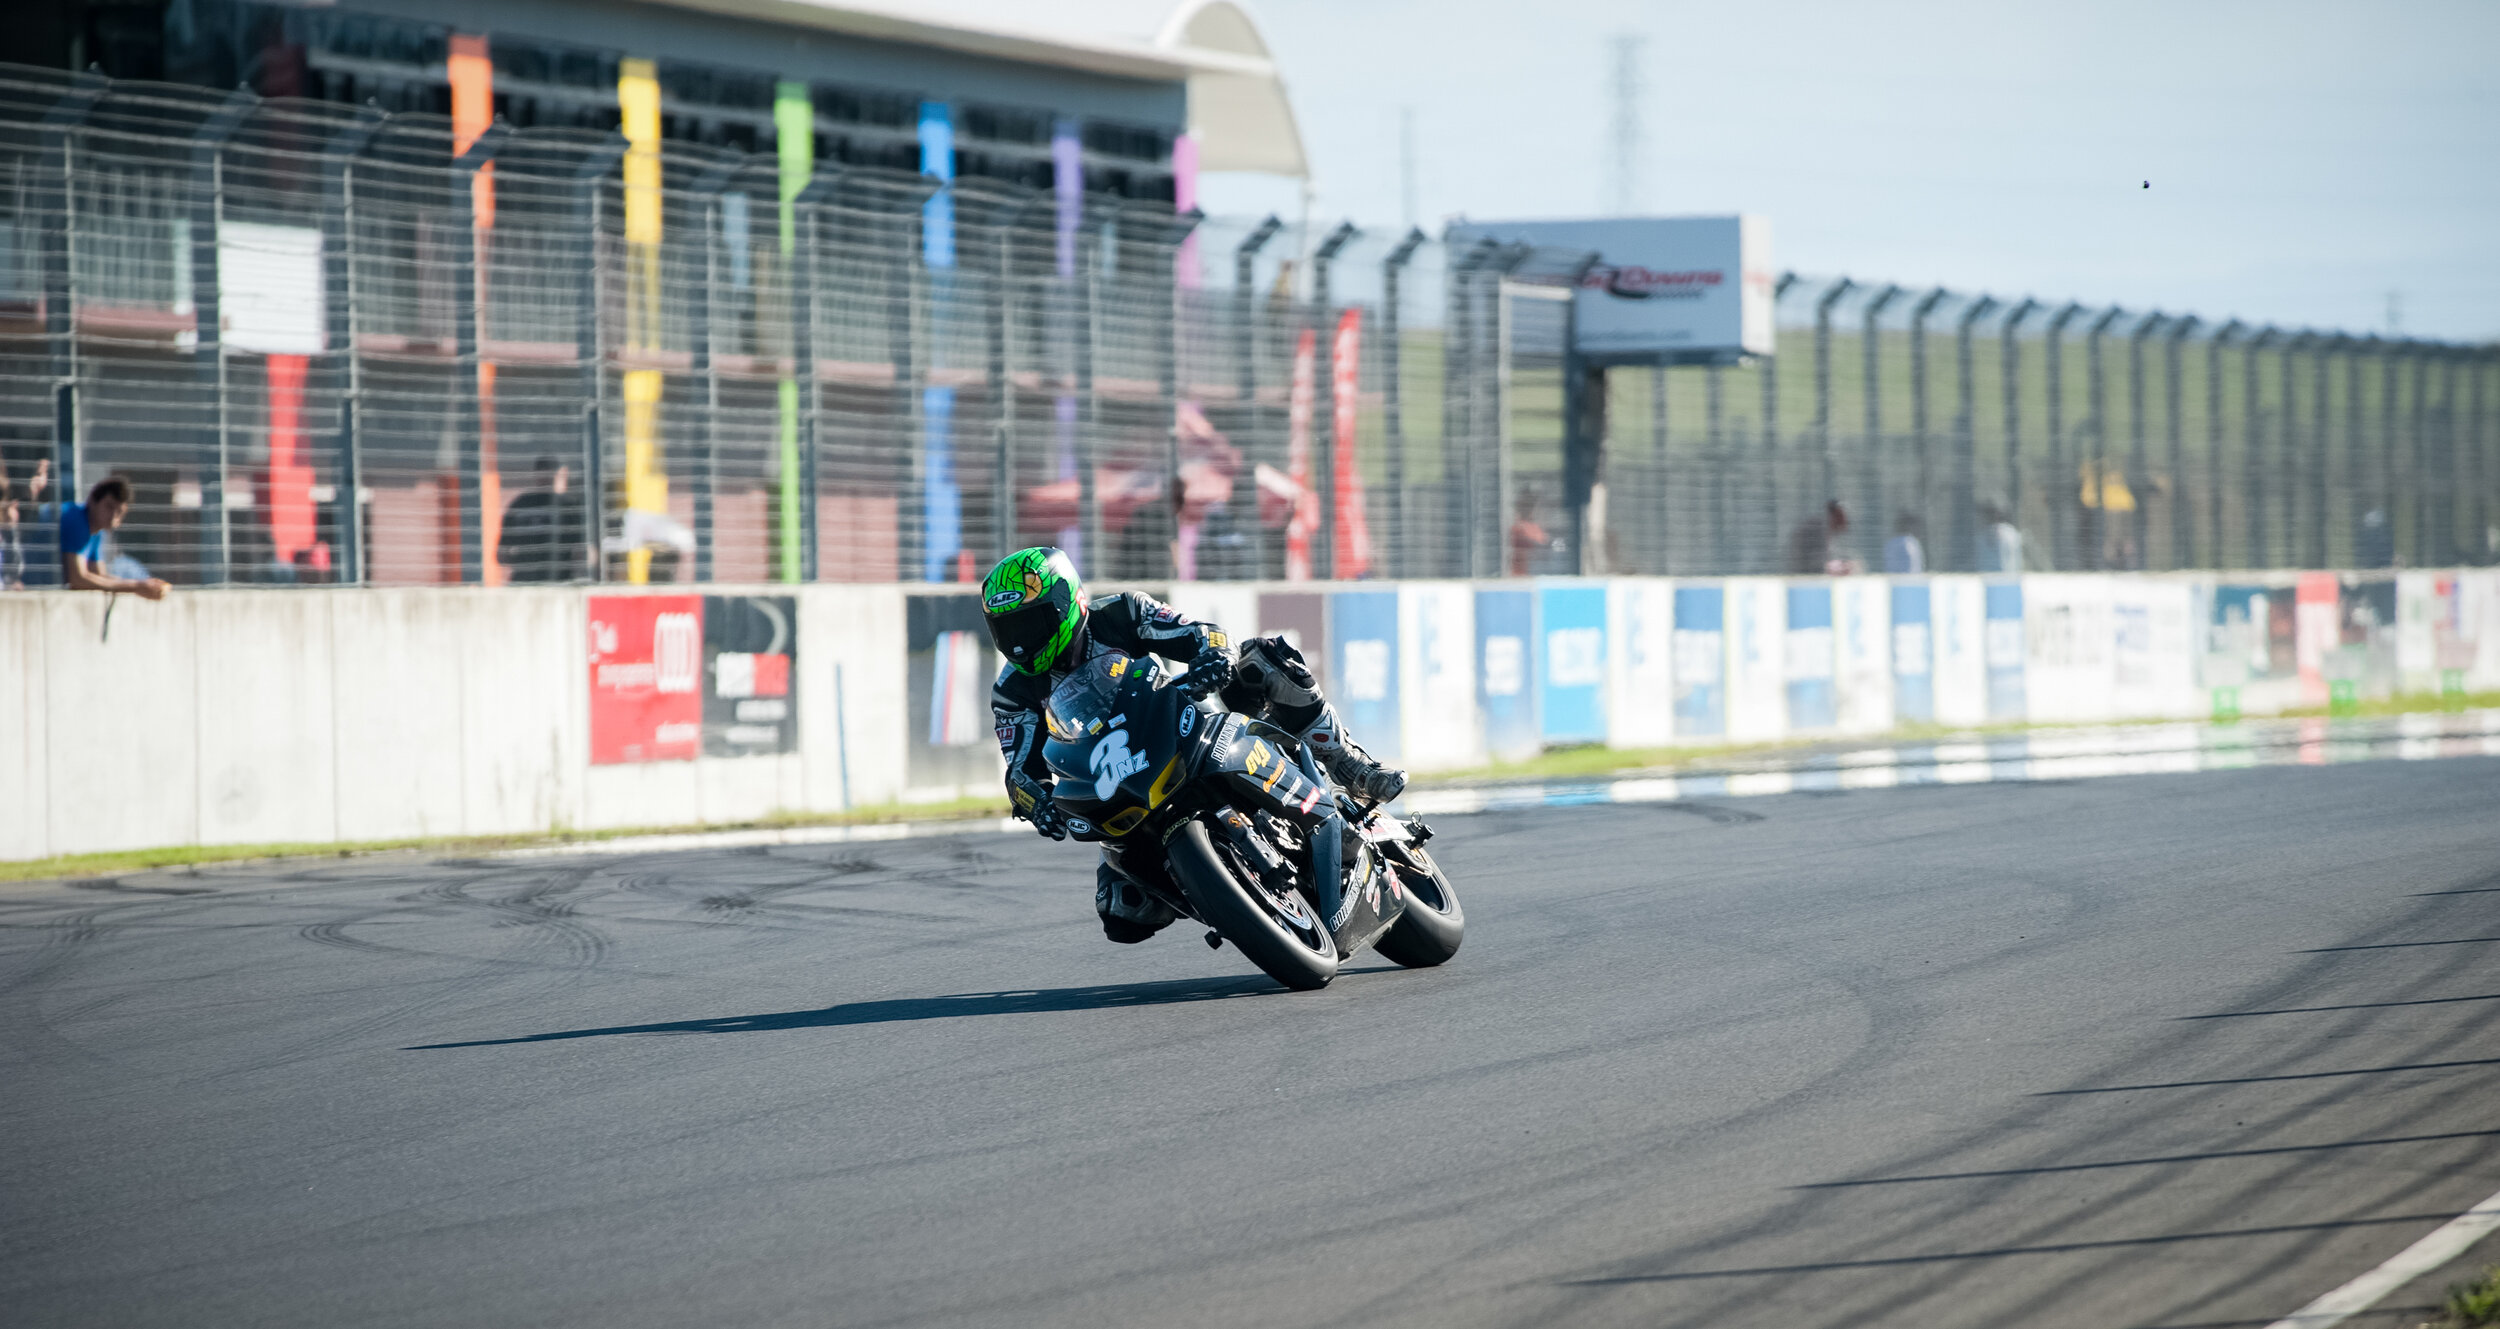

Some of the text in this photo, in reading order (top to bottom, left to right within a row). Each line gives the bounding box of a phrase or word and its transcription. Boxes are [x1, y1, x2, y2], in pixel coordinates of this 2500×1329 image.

[989, 591, 1020, 605] HJC
[1182, 706, 1194, 733] HJC
[1089, 729, 1130, 802] 3
[1116, 748, 1150, 782] NZ
[1067, 820, 1088, 832] HJC
